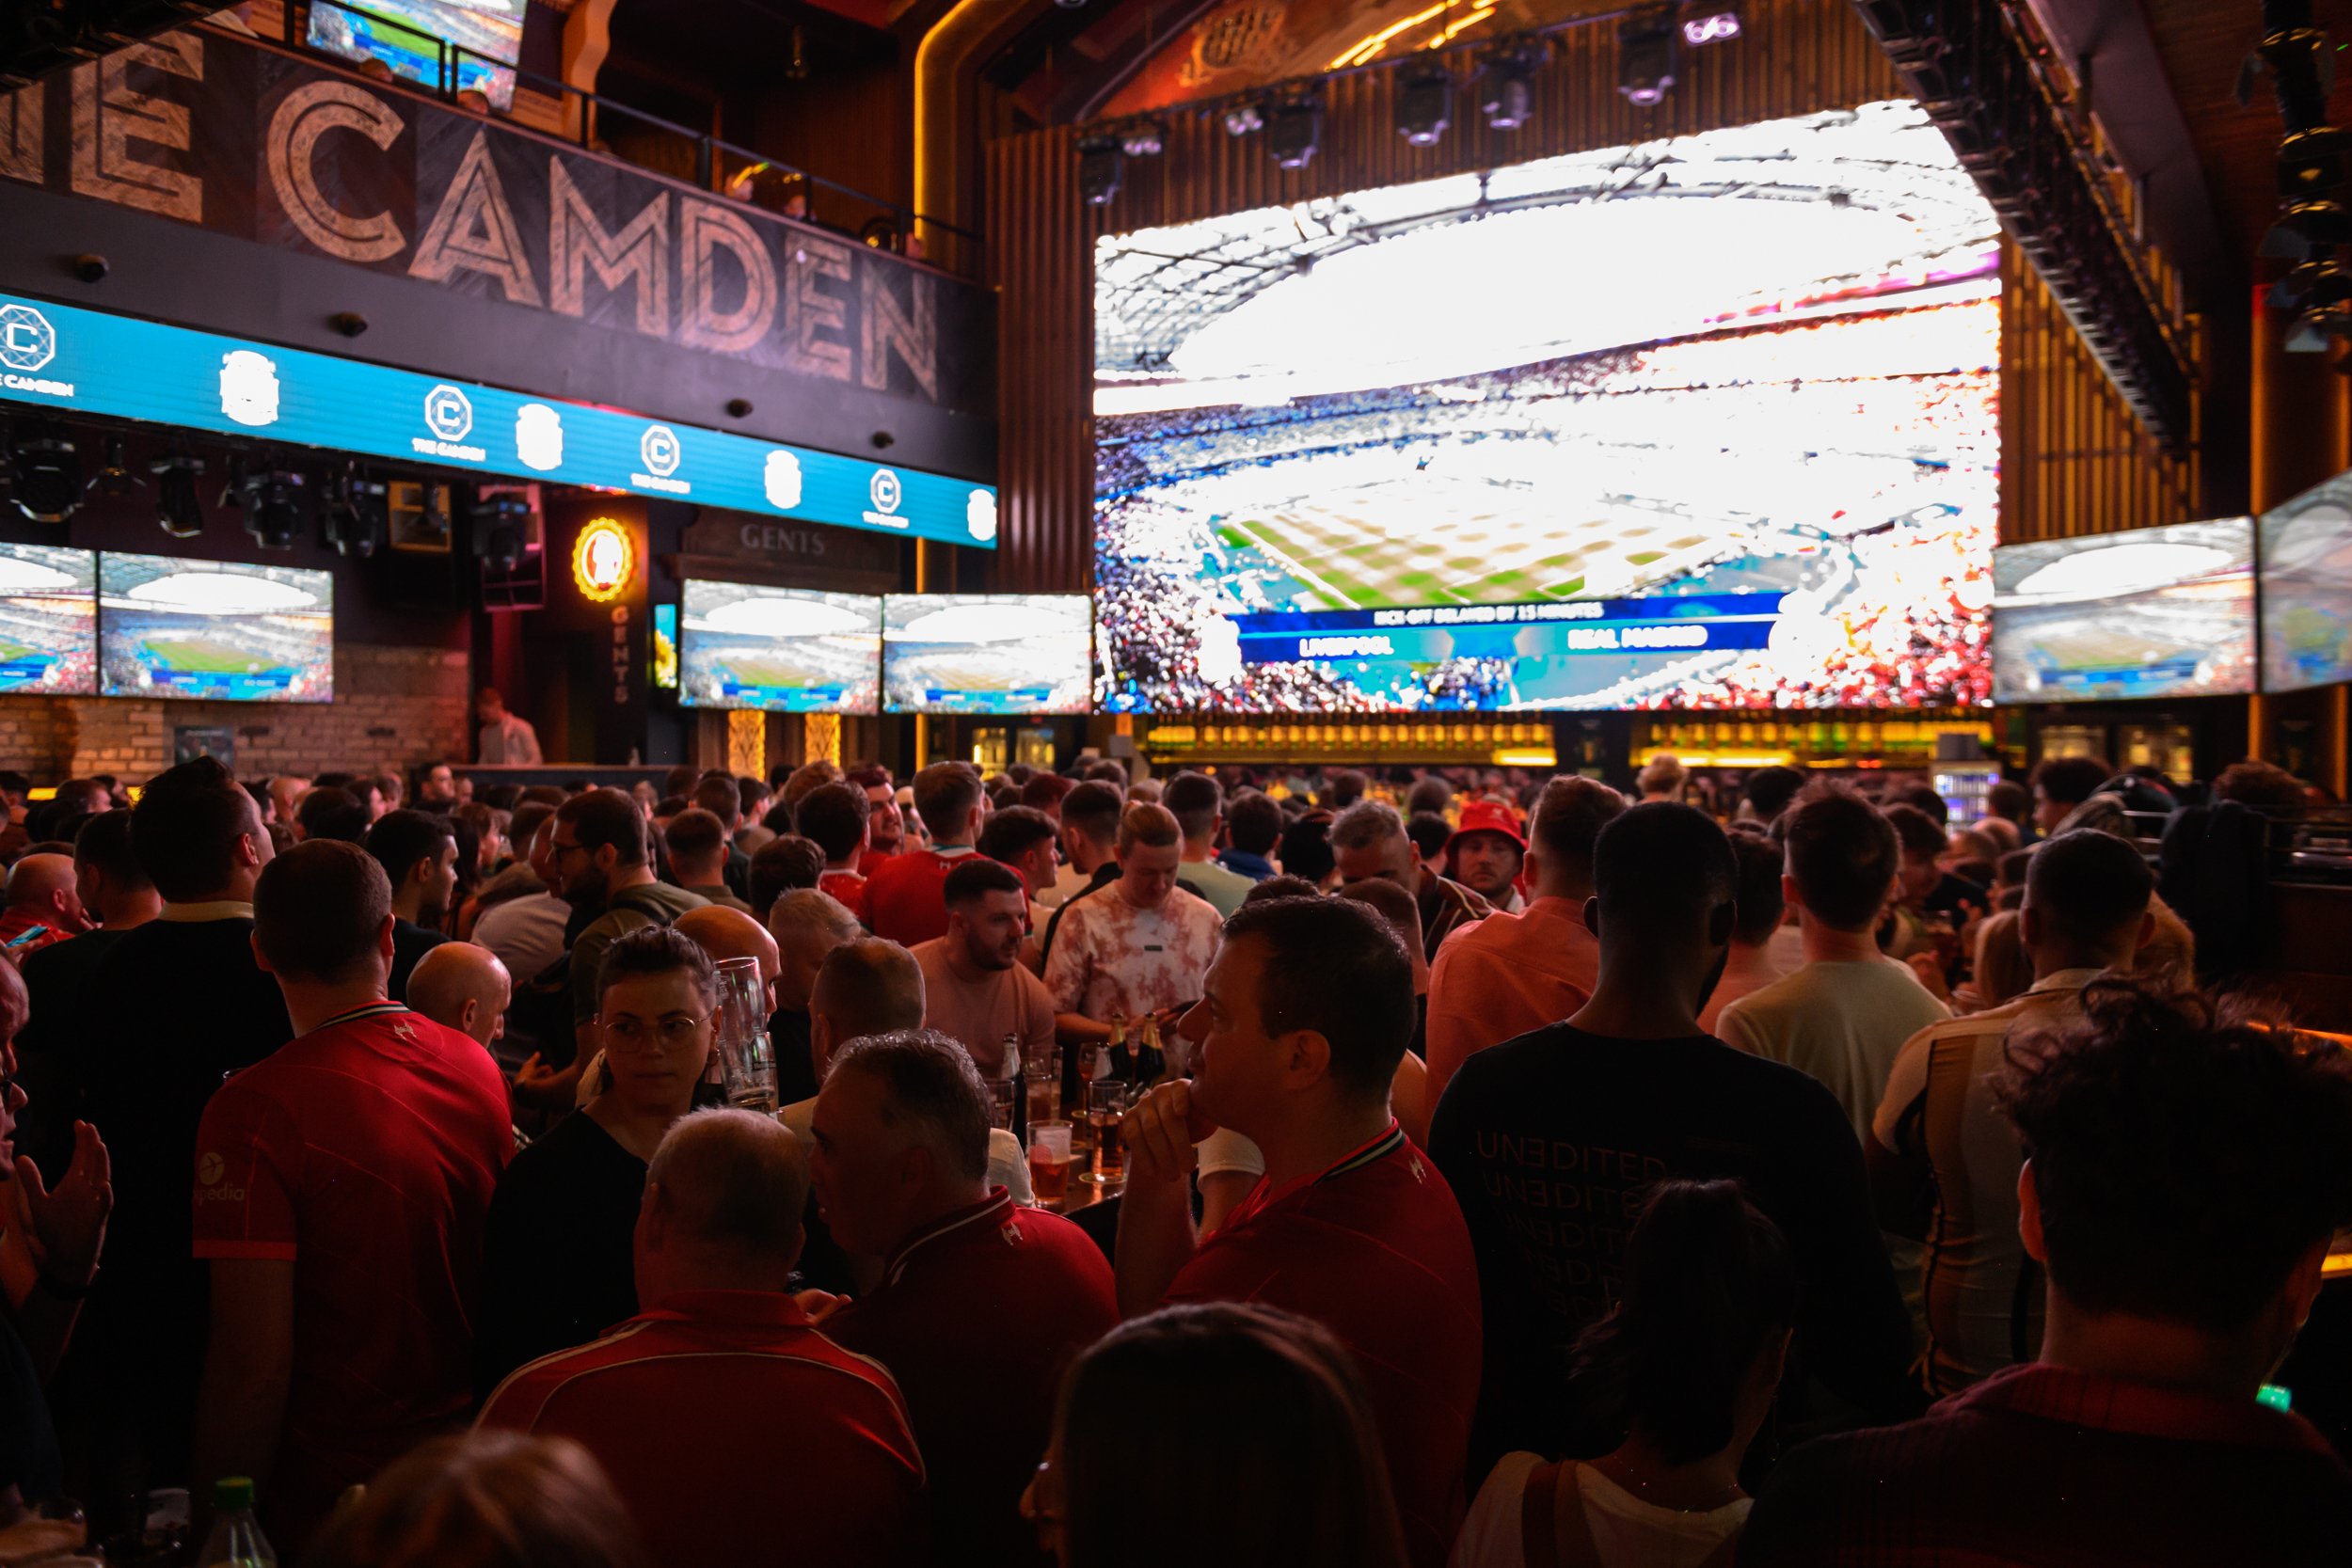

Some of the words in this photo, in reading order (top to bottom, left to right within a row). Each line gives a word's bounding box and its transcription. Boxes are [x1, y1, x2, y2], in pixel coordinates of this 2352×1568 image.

[265, 79, 940, 404] CAMDEN
[739, 523, 826, 556] GENTS
[612, 605, 629, 704] GENTS
[1299, 636, 1394, 657] LIVERPOOL
[1567, 628, 1620, 649] REAL
[1621, 625, 1708, 648] MADRID
